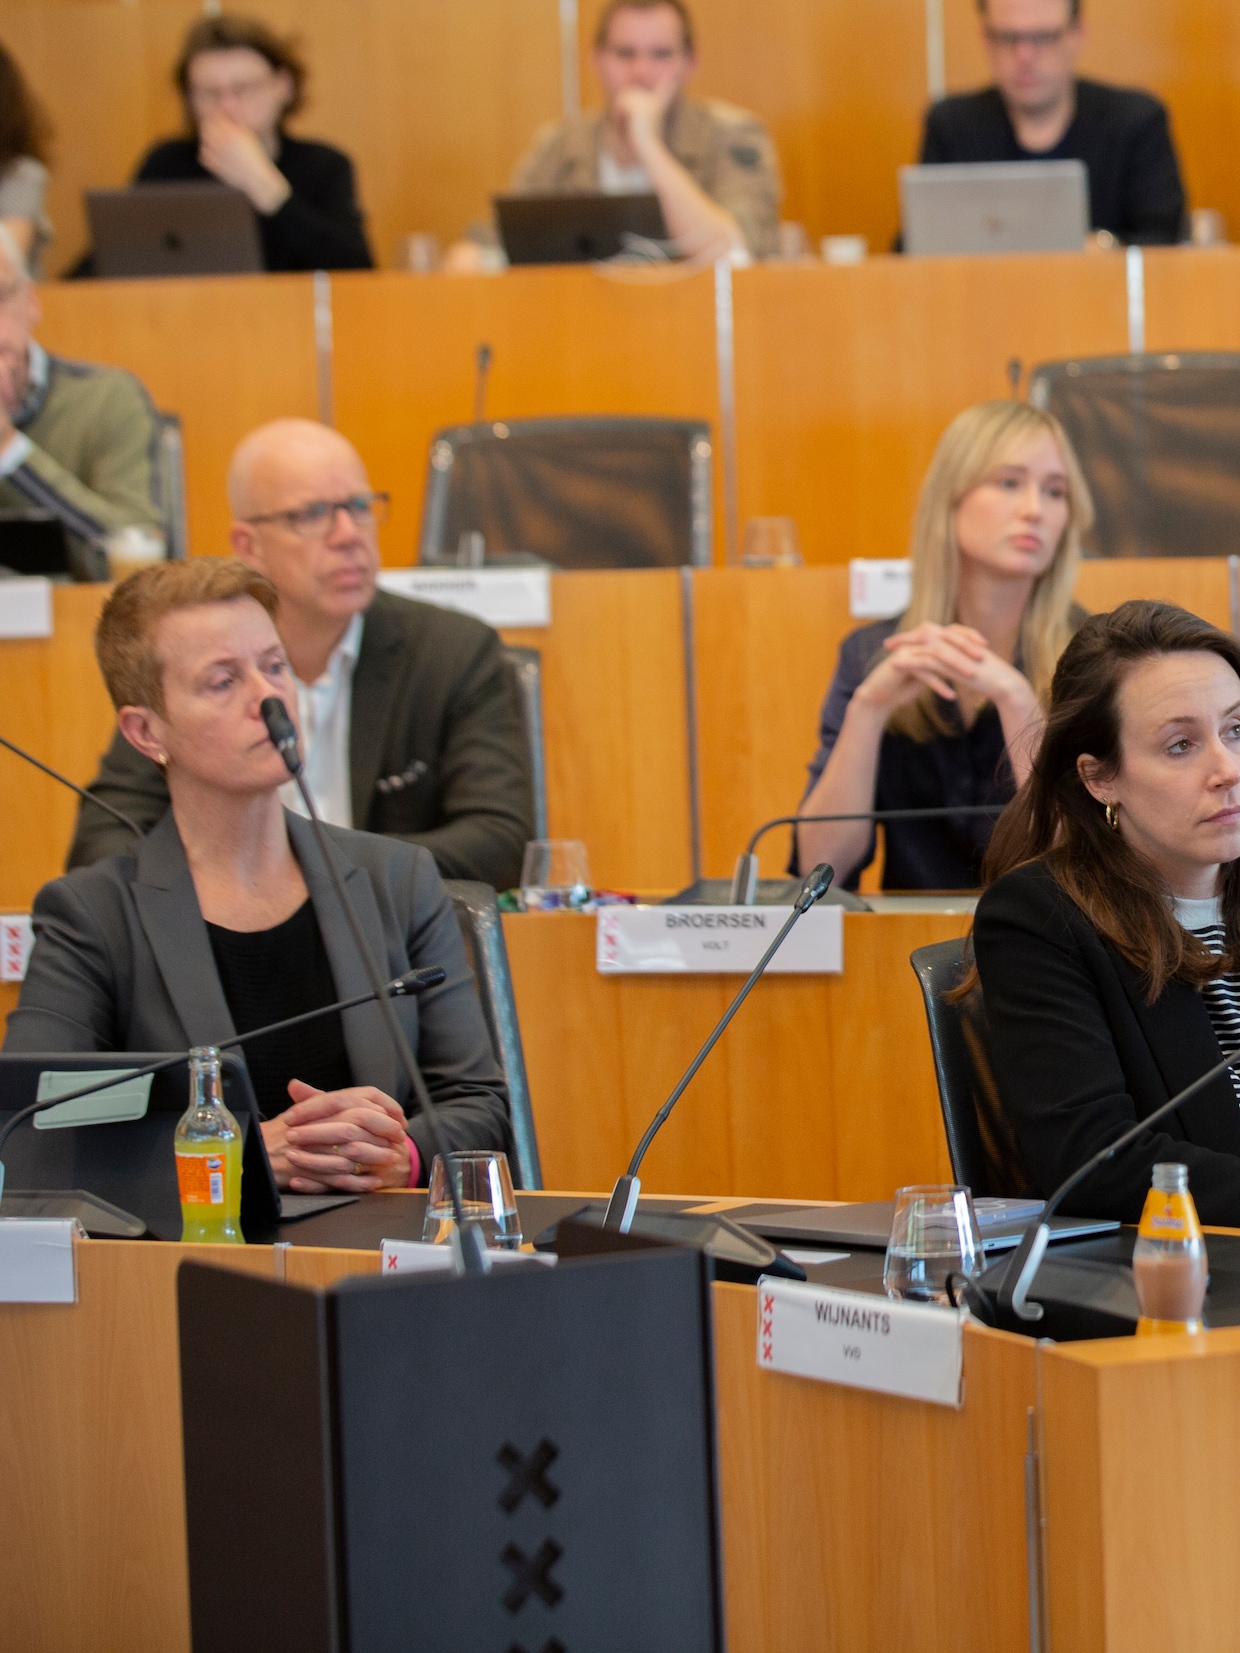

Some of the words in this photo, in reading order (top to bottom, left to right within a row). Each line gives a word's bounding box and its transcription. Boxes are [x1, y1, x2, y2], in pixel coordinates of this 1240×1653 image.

[665, 913, 766, 929] BROERSEN
[702, 940, 729, 950] VOLT
[815, 1300, 891, 1335] WIJNANTS
